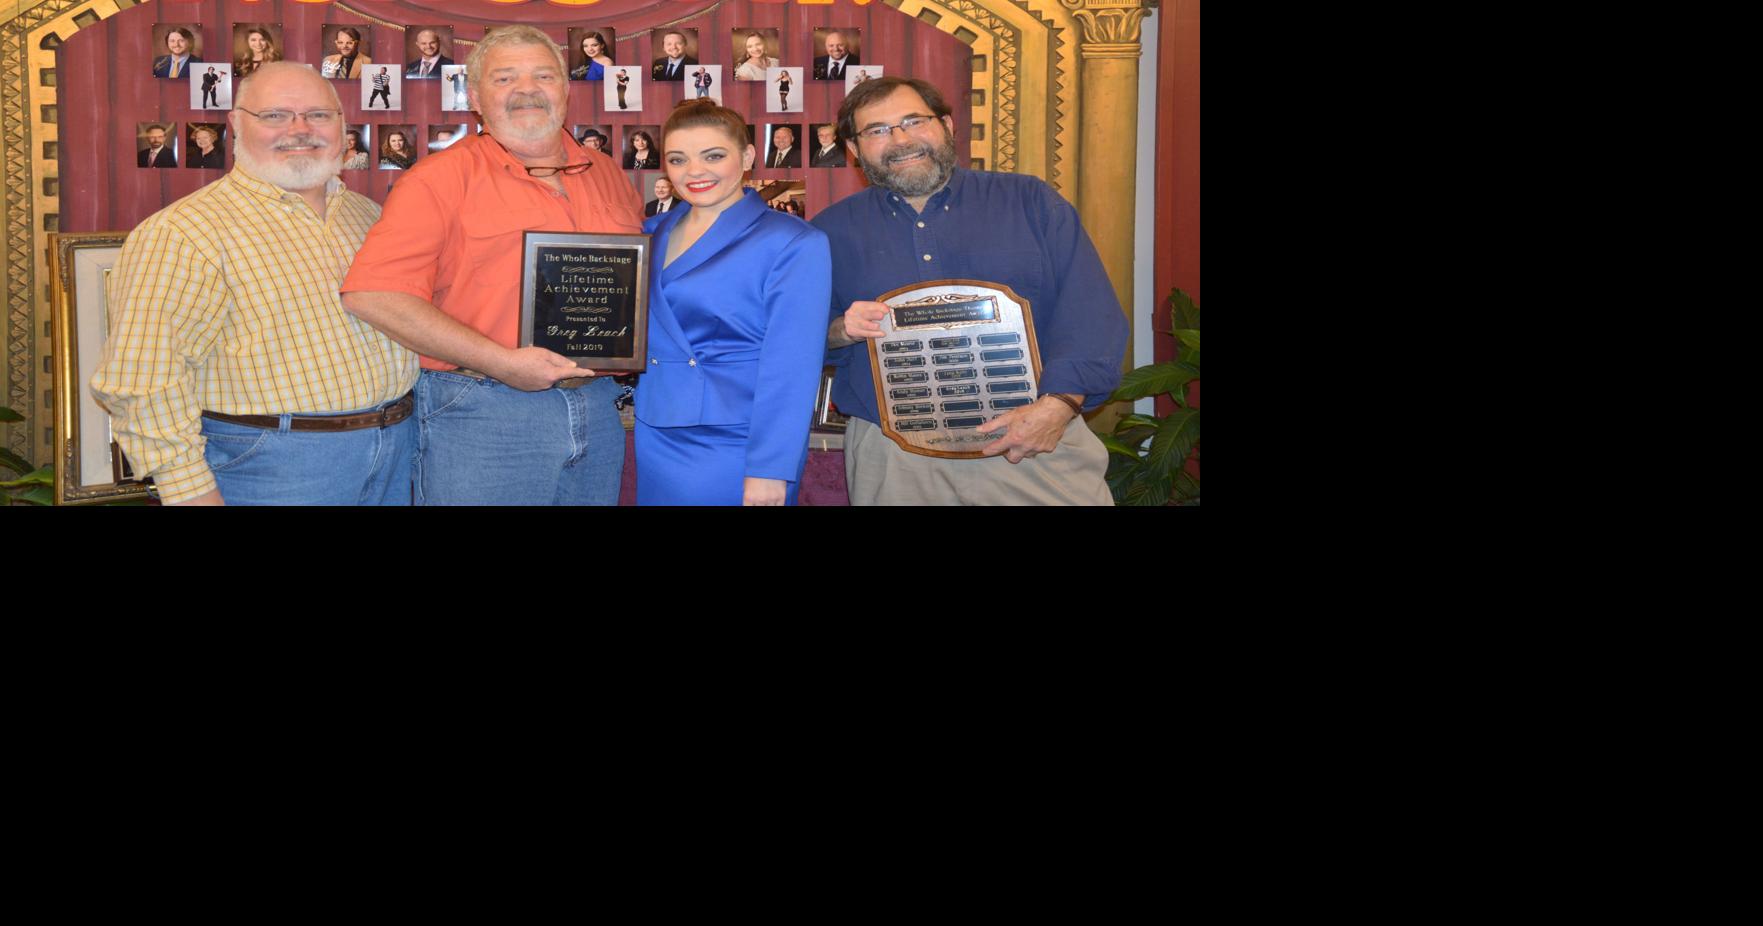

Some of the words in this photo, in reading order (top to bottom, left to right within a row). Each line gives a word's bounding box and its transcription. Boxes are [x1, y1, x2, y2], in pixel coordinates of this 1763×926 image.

[545, 254, 560, 262] The
[562, 254, 587, 263] Whole
[588, 254, 632, 264] Backstage
[560, 275, 615, 284] Lifetime
[544, 284, 629, 295] Achievement
[566, 295, 608, 304] Award
[547, 325, 578, 339] Greg
[583, 325, 628, 337] Leach
[566, 343, 582, 351] Fall
[583, 343, 603, 351] 2019
